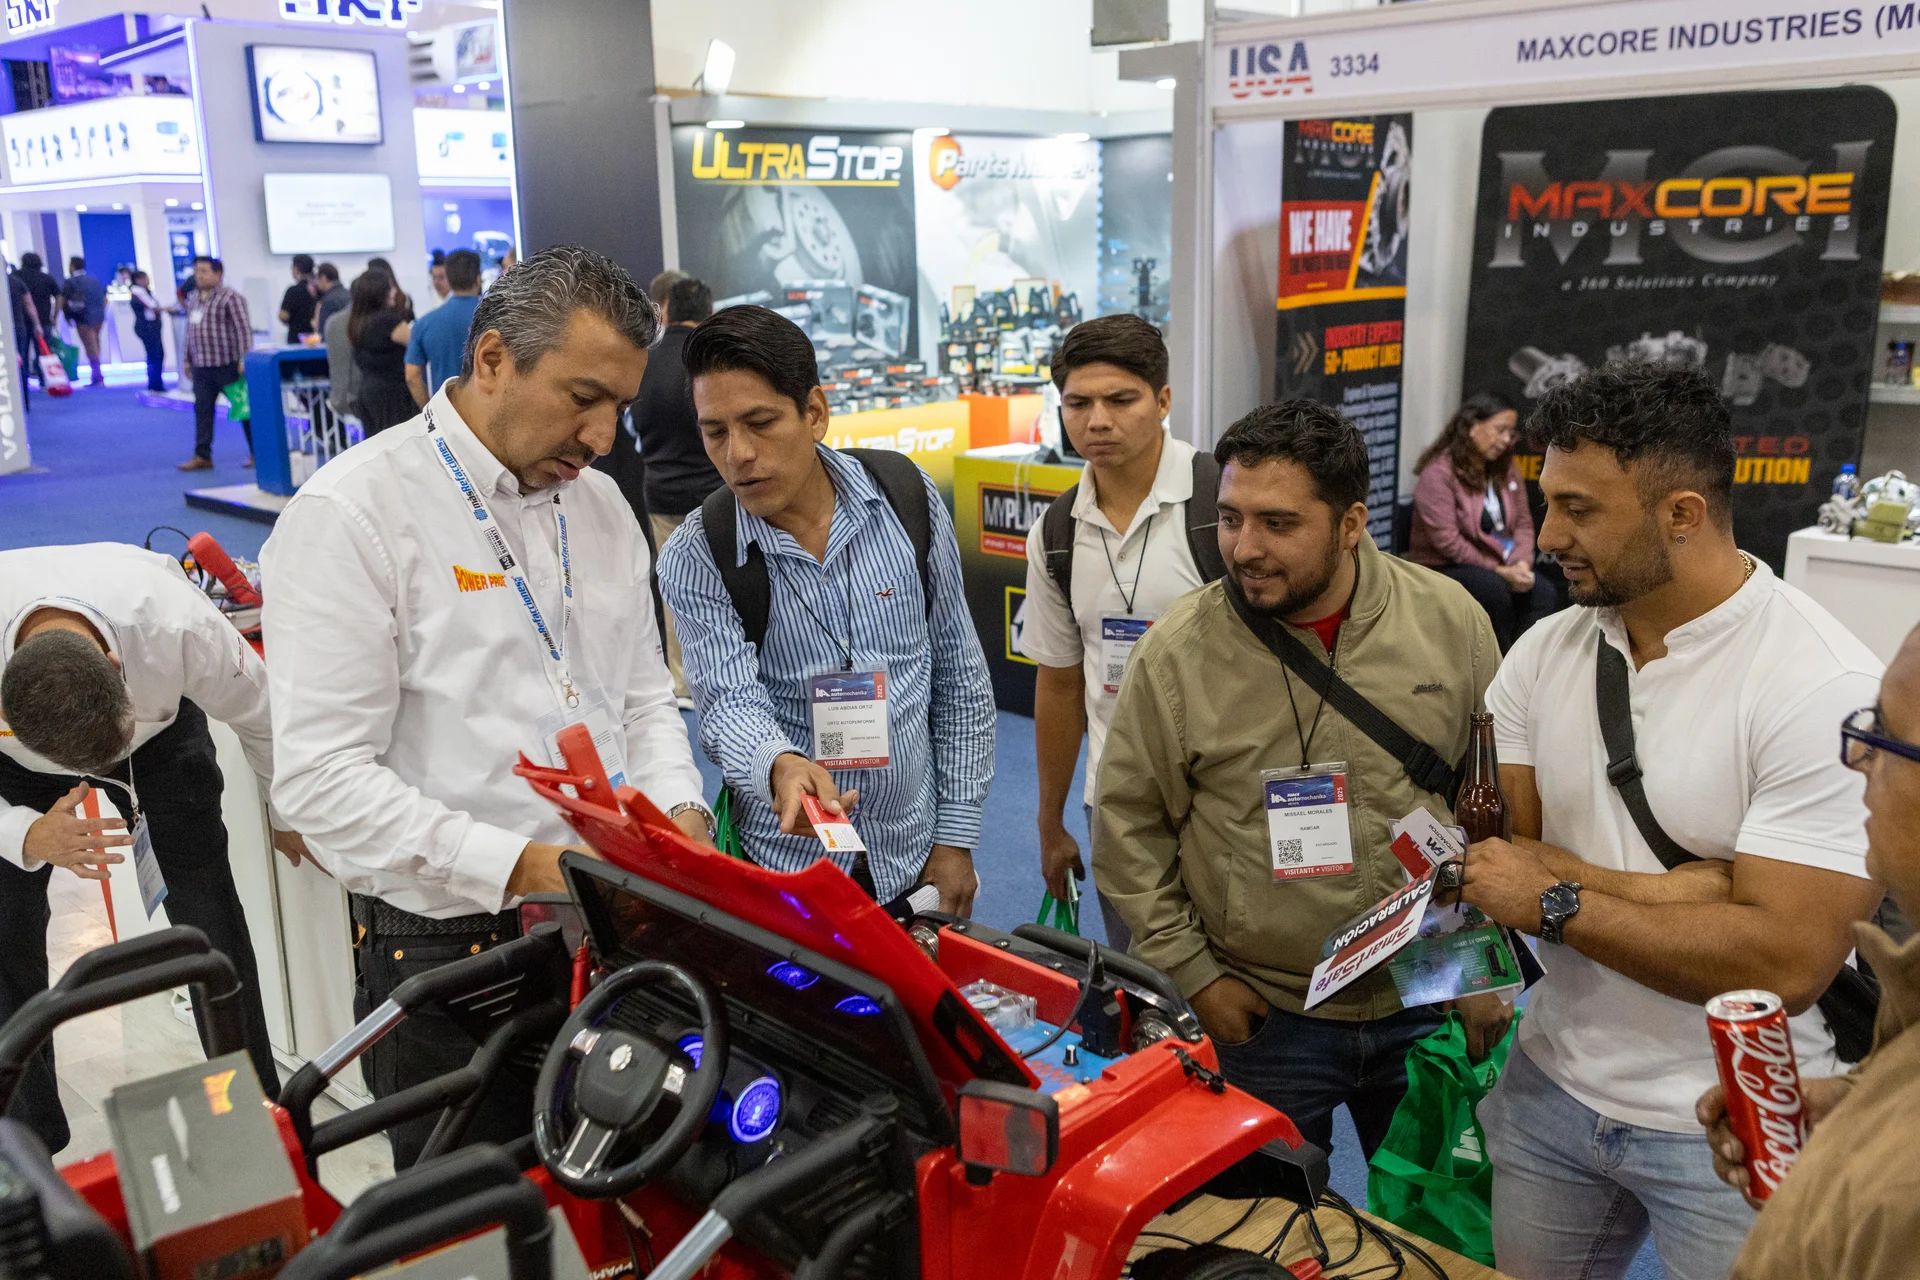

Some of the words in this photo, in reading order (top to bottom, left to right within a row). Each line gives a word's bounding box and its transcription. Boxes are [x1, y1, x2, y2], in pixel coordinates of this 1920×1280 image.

[1330, 53, 1379, 77] 3334
[1516, 28, 1659, 63] MAXCORE
[1669, 9, 1862, 51] INDUSTRIES
[1507, 172, 1855, 222] MAXCORE
[1289, 210, 1314, 255] WE
[1315, 209, 1352, 253] HAVE
[1504, 215, 1851, 238] INDUSTRIES
[1614, 274, 1695, 291] Solutions
[1701, 272, 1780, 291] Company
[1734, 457, 1811, 484] UTION
[453, 565, 488, 593] POWER
[1287, 794, 1327, 802] automechanika
[1284, 866, 1314, 876] VISITANTE
[1321, 865, 1344, 873] VISITOR
[1332, 880, 1431, 951] CALIBRACIÓN
[1315, 918, 1415, 991] SmartSafe
[1727, 1021, 1800, 1191] Coca-Cola
